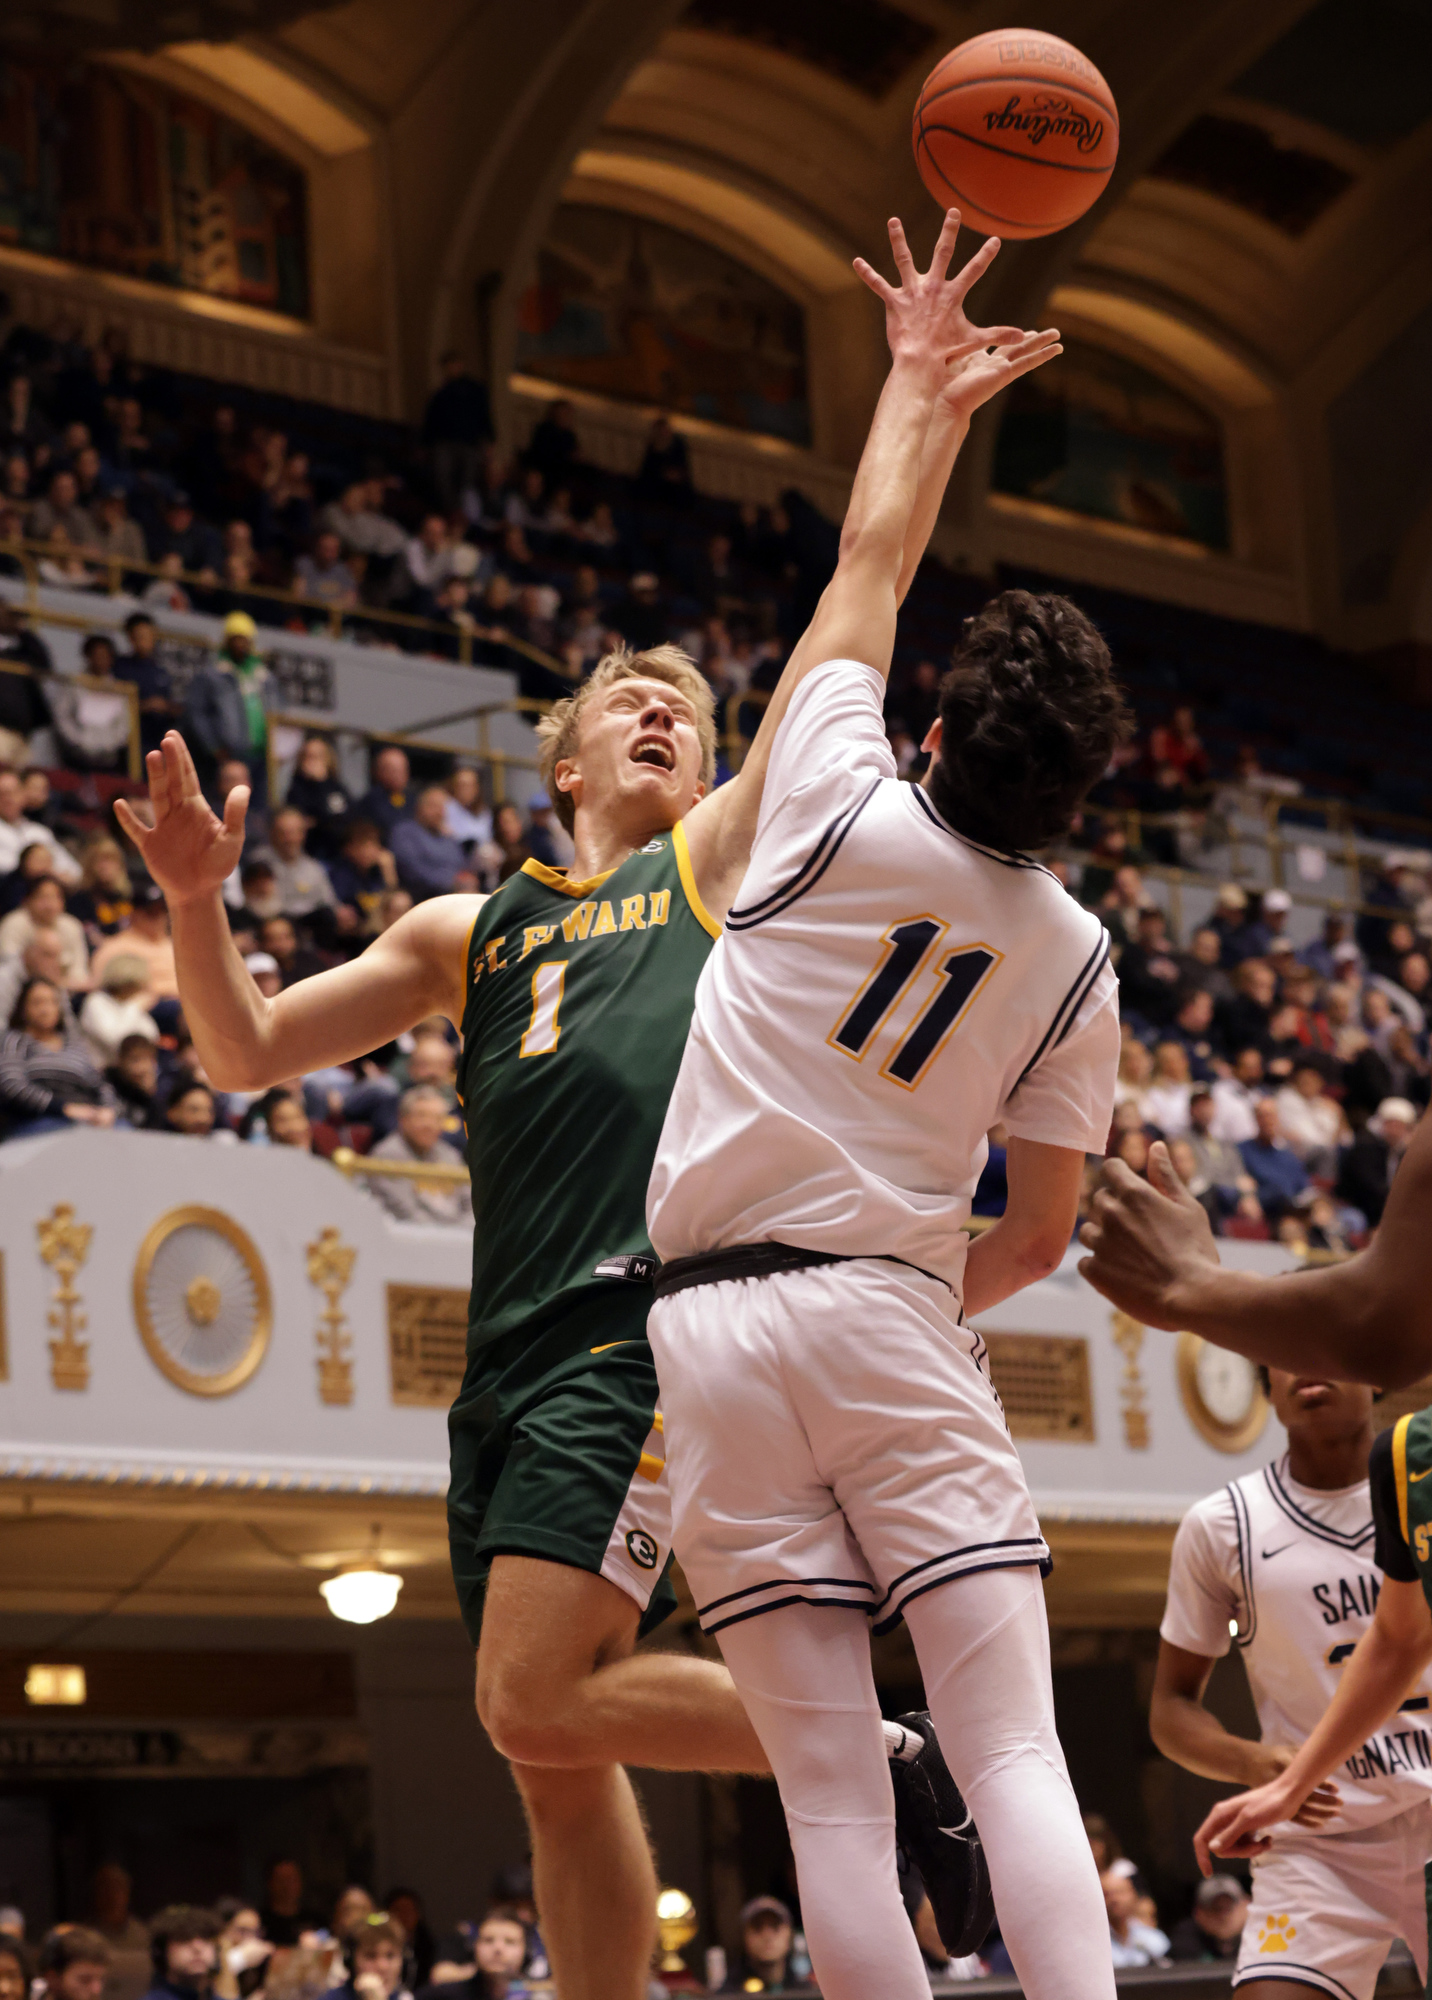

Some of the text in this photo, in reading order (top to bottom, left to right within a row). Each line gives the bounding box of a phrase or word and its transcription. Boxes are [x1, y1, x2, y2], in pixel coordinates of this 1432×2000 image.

[982, 95, 1104, 154] Rawlings
[519, 960, 569, 1059] 1
[825, 912, 1006, 1093] 11
[633, 1262, 648, 1277] M
[1413, 1521, 1432, 1562] S
